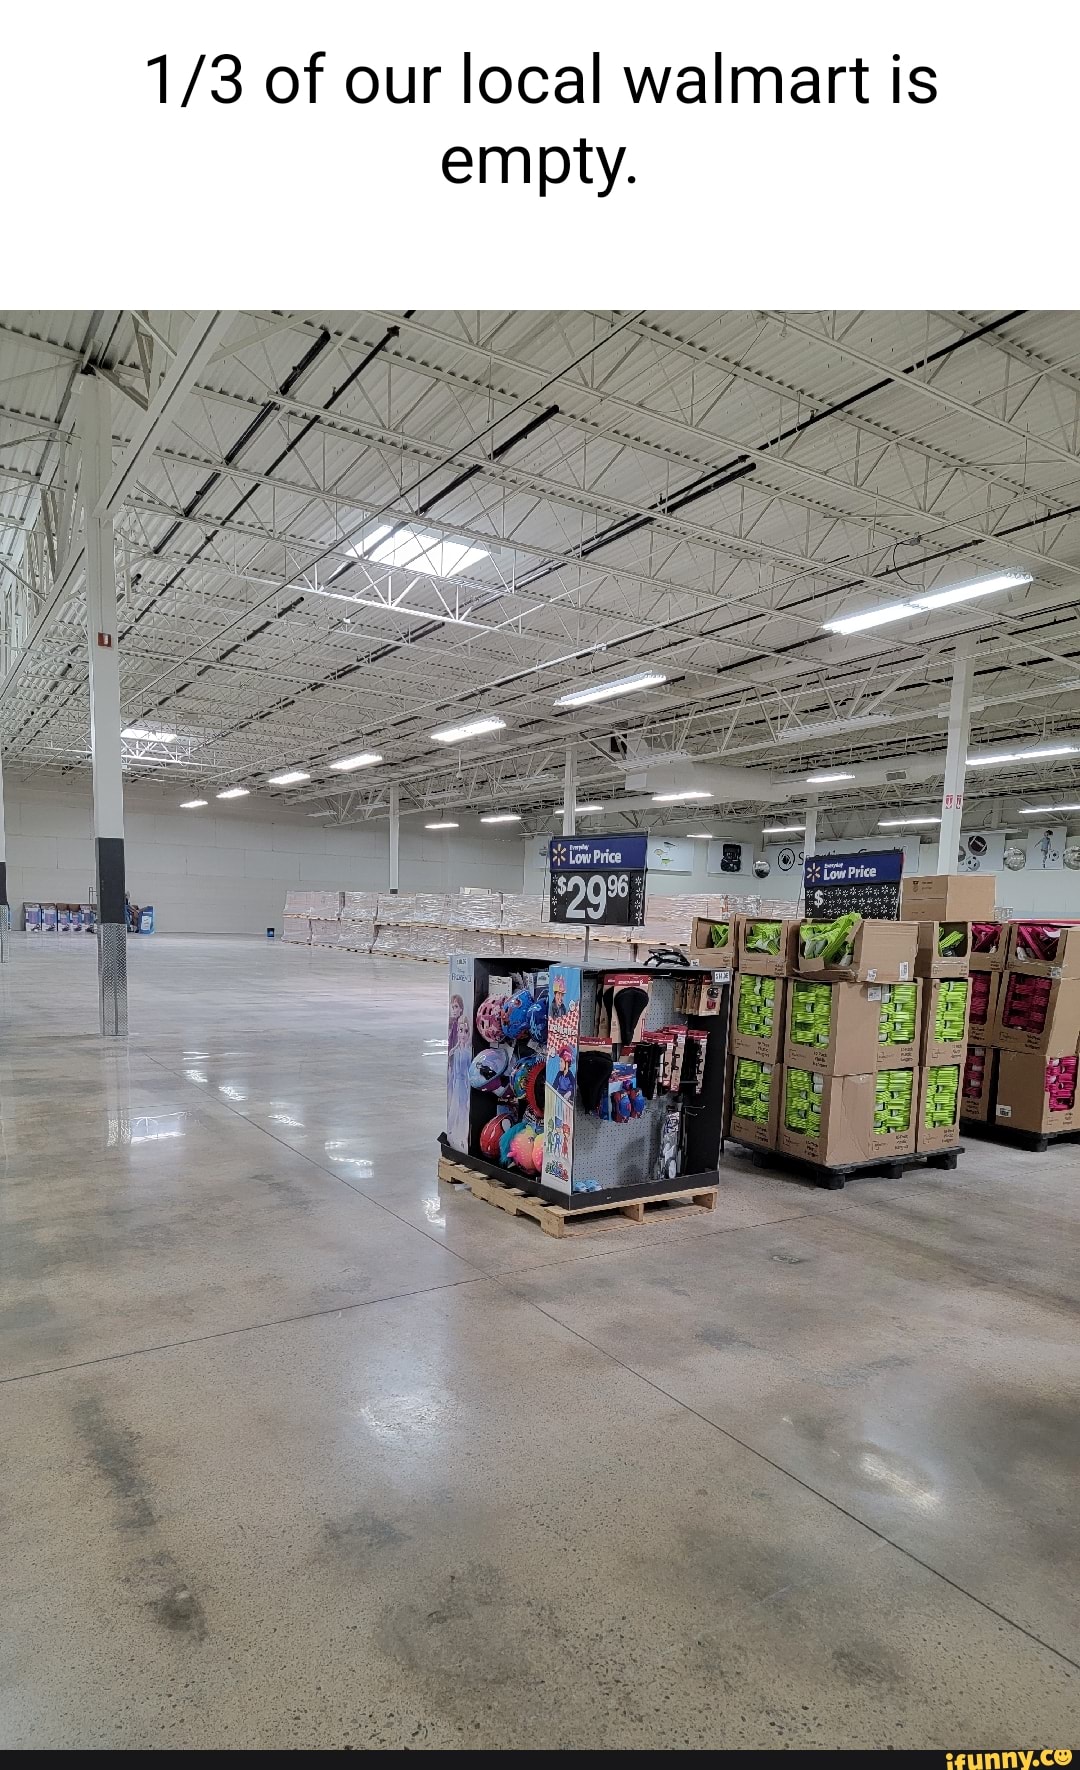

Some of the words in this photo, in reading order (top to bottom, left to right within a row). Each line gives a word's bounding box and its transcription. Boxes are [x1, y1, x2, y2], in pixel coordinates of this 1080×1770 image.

[569, 850, 591, 864] Low
[593, 849, 622, 864] Price
[823, 868, 847, 880] Low
[848, 865, 877, 879] Price
